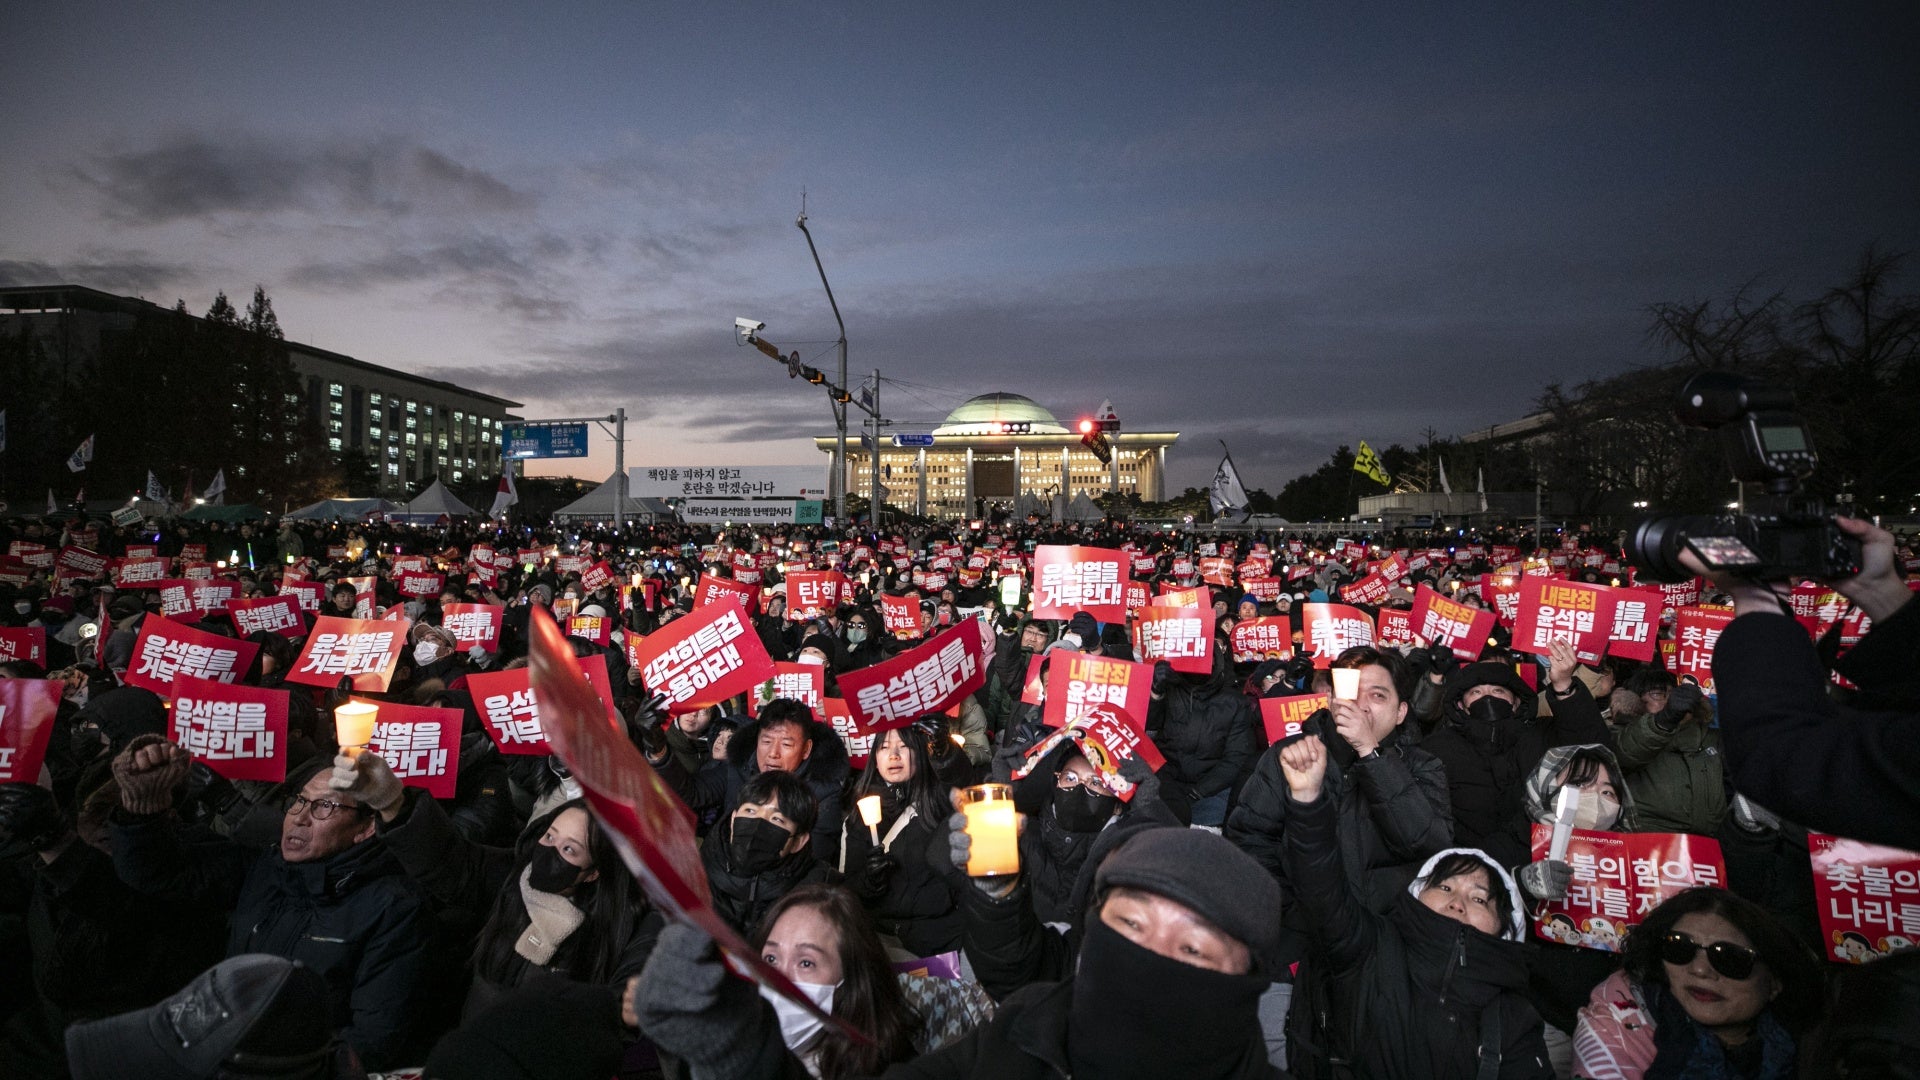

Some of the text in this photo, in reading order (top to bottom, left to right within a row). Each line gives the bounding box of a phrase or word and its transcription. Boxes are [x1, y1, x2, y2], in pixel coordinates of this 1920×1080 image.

[648, 467, 741, 481] 책임을 피하지 않고
[682, 481, 775, 494] 혼란을 막겠습니다
[687, 506, 792, 517] 내란수괴 윤석열을 탄핵합시다
[120, 570, 164, 583] 거부한다!
[121, 561, 163, 573] 윤석열을
[1042, 561, 1119, 586] 윤석열을
[161, 586, 185, 601] 석열을
[193, 587, 232, 598] 석열을
[798, 580, 837, 605] 탄핵
[1041, 582, 1122, 608] 거부한다!
[1126, 597, 1146, 607] 하라
[1127, 588, 1146, 598] 열을
[1366, 585, 1387, 599] 지키자
[1496, 592, 1520, 609] 윤석
[1539, 585, 1597, 611] 내란죄
[1662, 593, 1685, 606] 석열
[235, 602, 289, 623] 윤석열을
[444, 612, 492, 628] 윤석열을
[882, 601, 908, 617] 란수괴
[1428, 595, 1477, 625] 내란죄
[1537, 605, 1595, 633] 윤석열
[240, 613, 298, 634] 거부한다!
[444, 626, 495, 642] 부한다!
[571, 617, 601, 629] 내란죄
[893, 616, 915, 629] 체포
[1142, 618, 1203, 640] 윤석열을
[1236, 625, 1280, 639] 윤석열을
[1311, 618, 1373, 642] 윤석열을
[1382, 626, 1411, 640] 윤석열
[1388, 616, 1409, 629] 내란
[1425, 609, 1471, 639] 윤석열
[310, 631, 394, 654] 윤석열을
[643, 609, 745, 689] 김건희특검
[1142, 637, 1207, 659] 거부한다!
[1236, 637, 1281, 651] 탄핵하라
[1533, 627, 1581, 651] 퇴진!
[1681, 625, 1723, 650] 촛불
[143, 634, 238, 674] 윤석열을
[300, 651, 393, 675] 거부한다!
[1680, 650, 1713, 672] 나라
[652, 642, 745, 711] 수용하라!
[756, 673, 813, 693] 석열을
[856, 637, 968, 711] 윤석열을
[1069, 658, 1131, 686] 내란죄
[862, 652, 976, 727] 거부한다!
[1066, 680, 1128, 709] 윤석열
[175, 698, 267, 732] 윤석열을
[485, 687, 540, 723] 윤석
[370, 722, 442, 750] 석열을
[1096, 708, 1140, 747] 수괴
[175, 727, 275, 760] 거부한다!
[370, 748, 448, 778] 한다!
[1568, 852, 1719, 888] 불의 힘으로
[1826, 861, 1920, 898] 촛불의
[1830, 896, 1920, 936] 나라를
